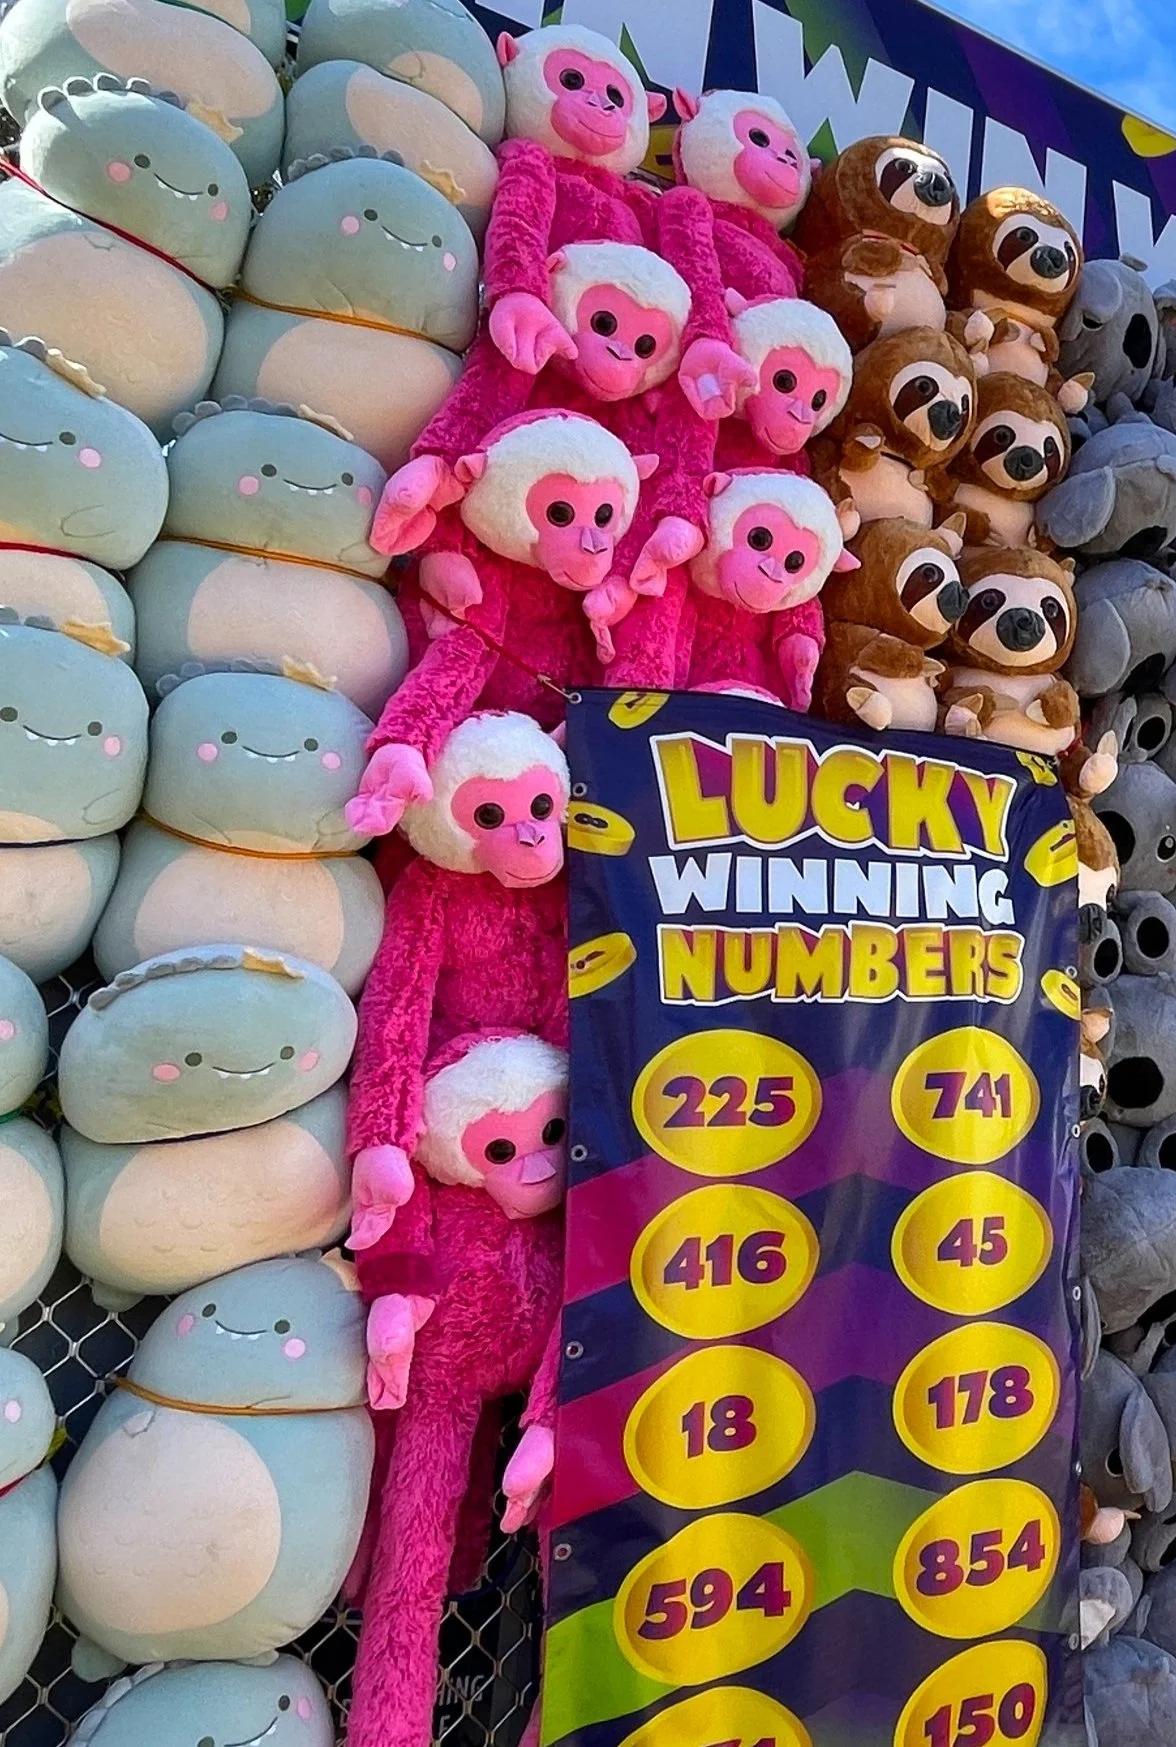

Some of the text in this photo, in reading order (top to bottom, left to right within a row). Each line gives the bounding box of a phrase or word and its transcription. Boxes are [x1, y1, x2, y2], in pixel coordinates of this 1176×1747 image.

[752, 0, 1087, 246] WIN
[649, 731, 1017, 862] LUCKY
[648, 852, 1015, 925] WINNING
[656, 919, 1025, 1006] NUMBERS
[661, 1074, 796, 1129] 225
[923, 1071, 1013, 1119] 741
[662, 1230, 787, 1291] 416
[936, 1216, 1008, 1267] 45
[681, 1395, 757, 1458] 18
[927, 1364, 1034, 1430] 178
[915, 1520, 1045, 1597] 854
[637, 1561, 791, 1641] 594
[924, 1682, 1036, 1747] 150
